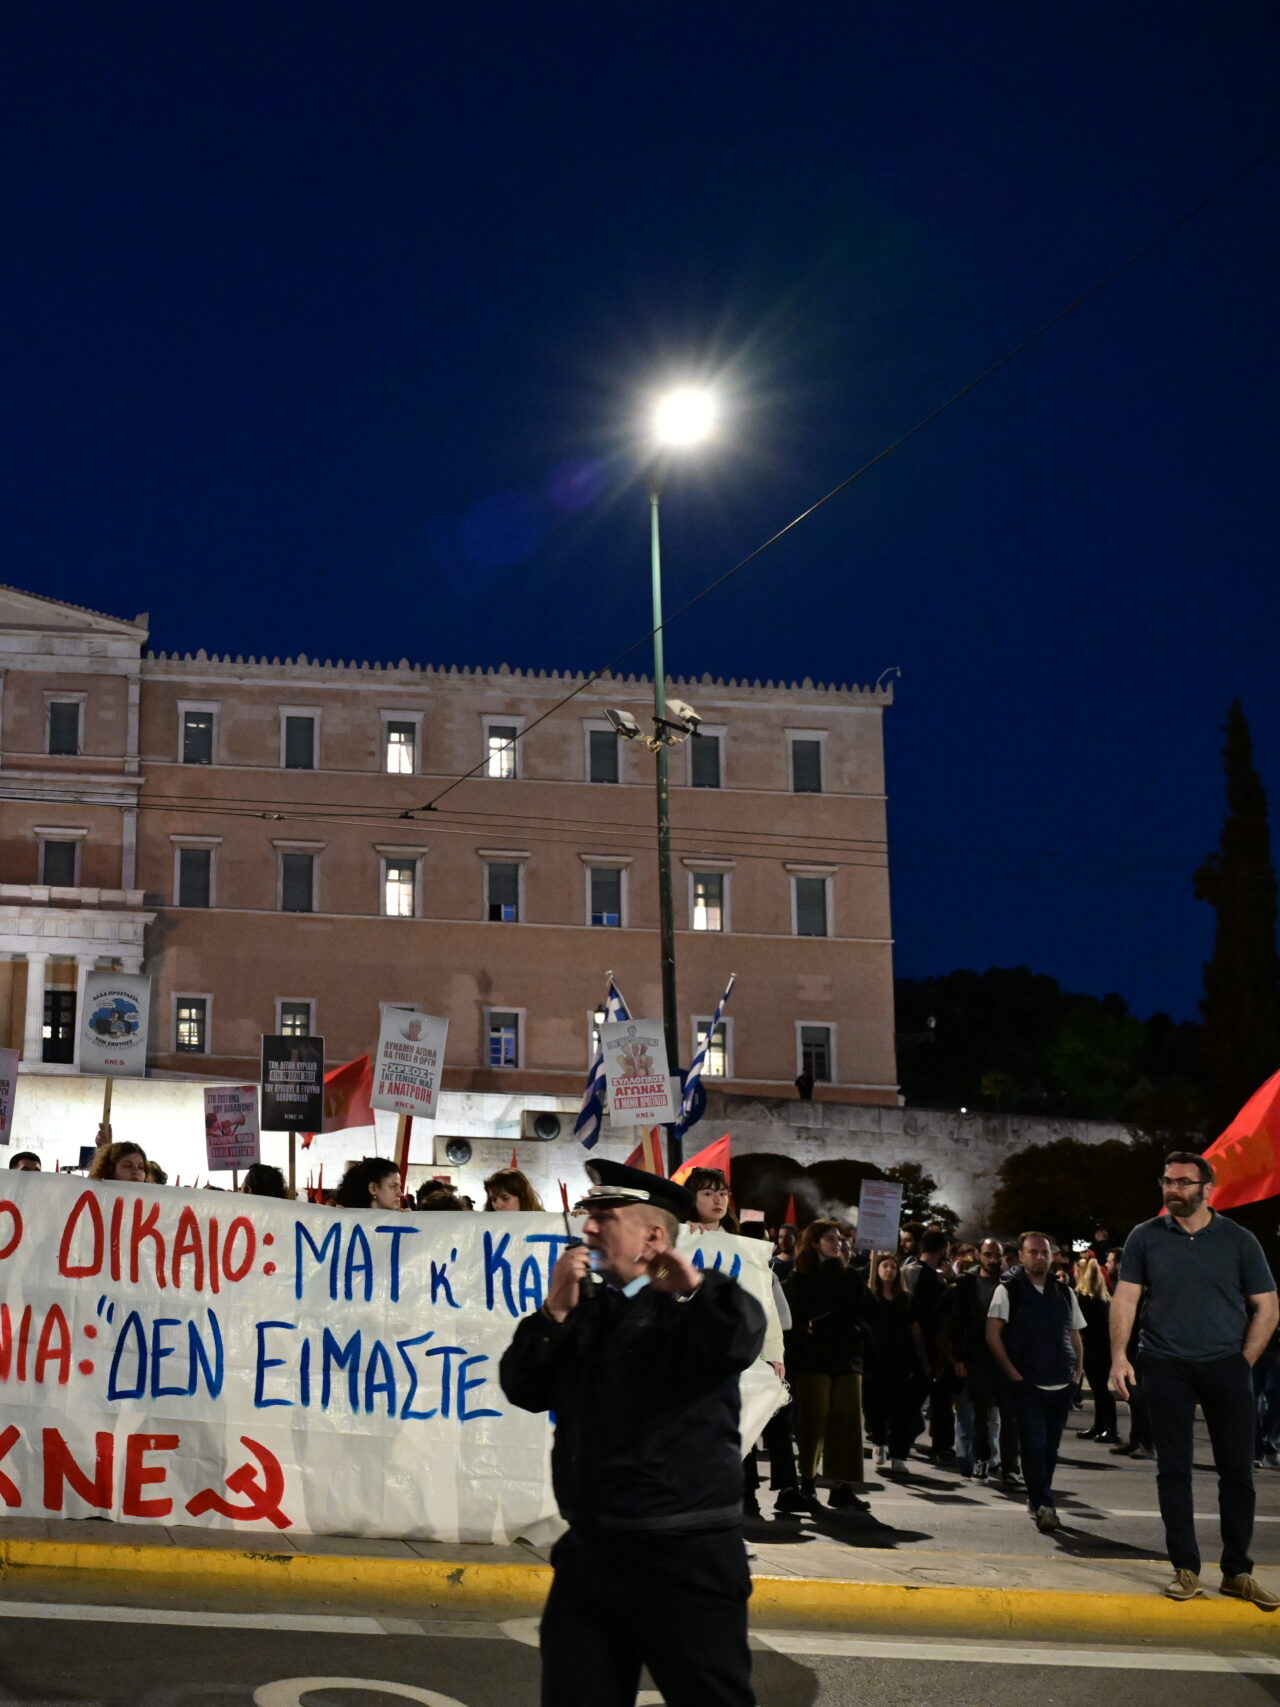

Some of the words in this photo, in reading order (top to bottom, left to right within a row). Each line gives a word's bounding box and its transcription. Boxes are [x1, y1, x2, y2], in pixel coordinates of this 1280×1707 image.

[384, 1050, 393, 1058] ΝΑ
[395, 1051, 412, 1062] ΓΙΝΕΙ
[420, 1056, 436, 1067] ΟΡΓΗ
[385, 1042, 414, 1052] ΔΥΝΑΜΗ
[416, 1046, 437, 1058] ΑΓΩΝΑ
[382, 1069, 394, 1080] ΤΗΣ
[396, 1073, 417, 1083] ΓΕΝΙΑΣ
[419, 1078, 433, 1089] ΜΑΣ
[613, 1076, 664, 1085] ΣΥΛΛΟΓΙΚΟΣ
[379, 1082, 385, 1095] Η
[387, 1082, 432, 1104] ΑΝΑΤΡΟΠΗ
[615, 1084, 664, 1096] ΑΓΩΝΑΣ
[395, 1101, 409, 1109] ΚΝΕ
[58, 1189, 277, 1293] ΔΙΚΑΙΟ:
[295, 1221, 420, 1304] ΜΑΤ
[253, 1319, 504, 1425] ΕΙΜΑΣΤΕ
